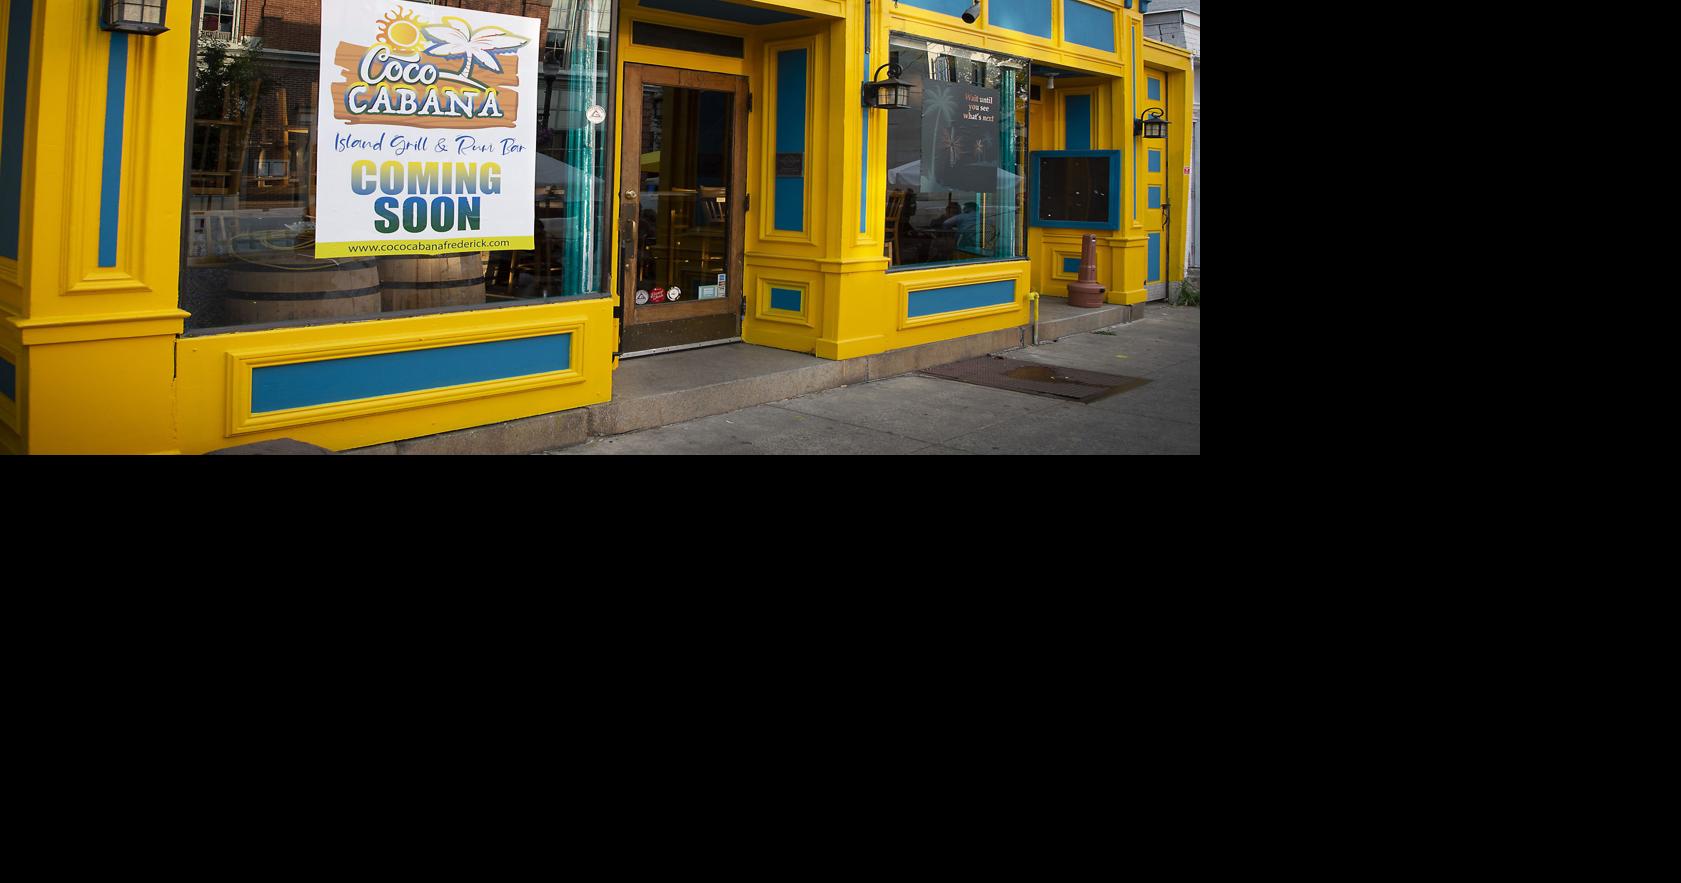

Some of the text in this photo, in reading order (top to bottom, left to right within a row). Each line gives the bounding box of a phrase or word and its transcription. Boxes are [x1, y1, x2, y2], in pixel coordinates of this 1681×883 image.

[360, 45, 437, 85] Coco
[348, 86, 503, 118] CABANA
[979, 96, 993, 104] until
[963, 112, 982, 120] what's
[334, 132, 527, 156] Island Grill & Rum Bar
[351, 159, 501, 196] COMING
[374, 196, 481, 234] SOON
[348, 239, 510, 253] www.cococabanafrederick.com
